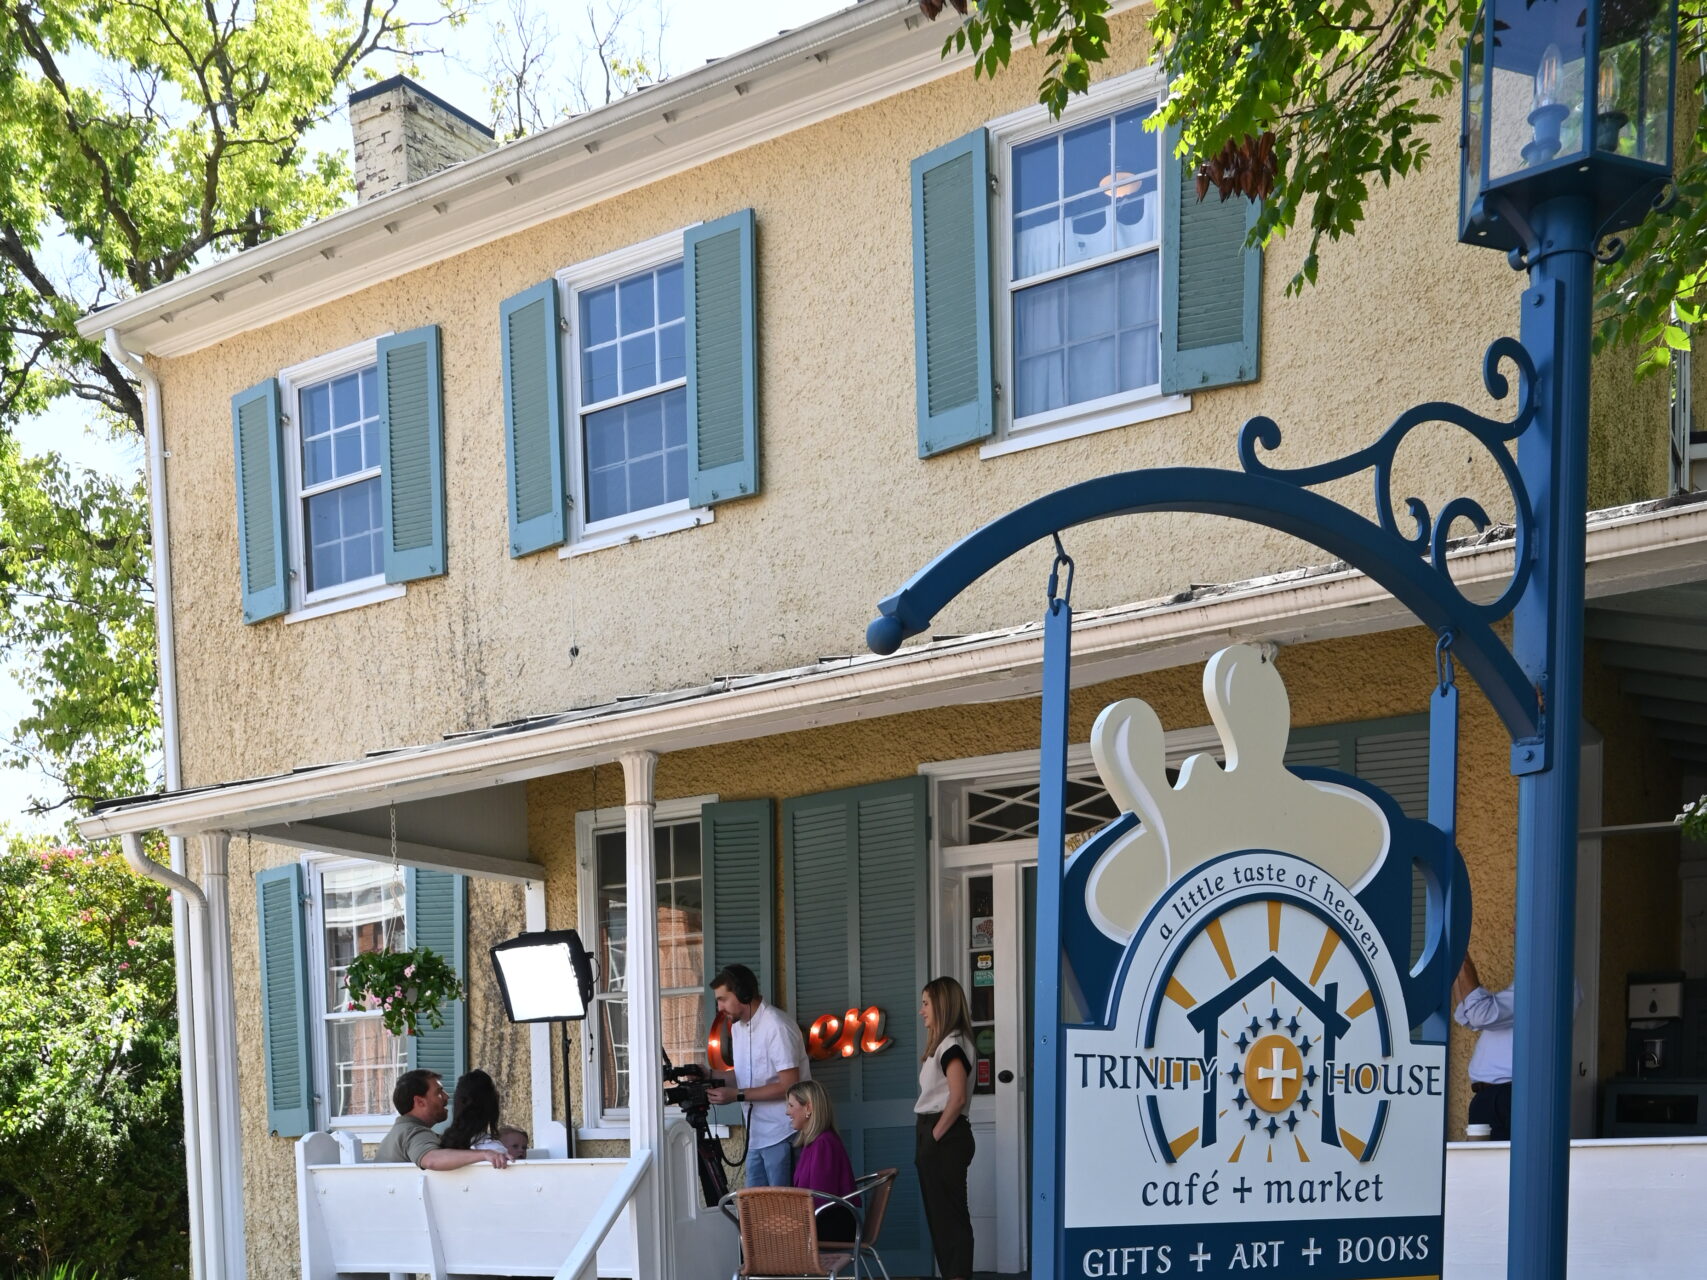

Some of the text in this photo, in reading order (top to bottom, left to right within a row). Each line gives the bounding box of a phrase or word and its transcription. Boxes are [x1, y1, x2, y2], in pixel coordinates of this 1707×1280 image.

[1159, 863, 1381, 960] a little taste of heaven
[1074, 1053, 1443, 1096] TRINITY HOUSE
[1141, 1169, 1220, 1207] café
[1264, 1171, 1384, 1204] market
[1082, 1245, 1172, 1278] GIFTS
[1228, 1240, 1285, 1270] ART
[1337, 1234, 1430, 1264] BOOKS
